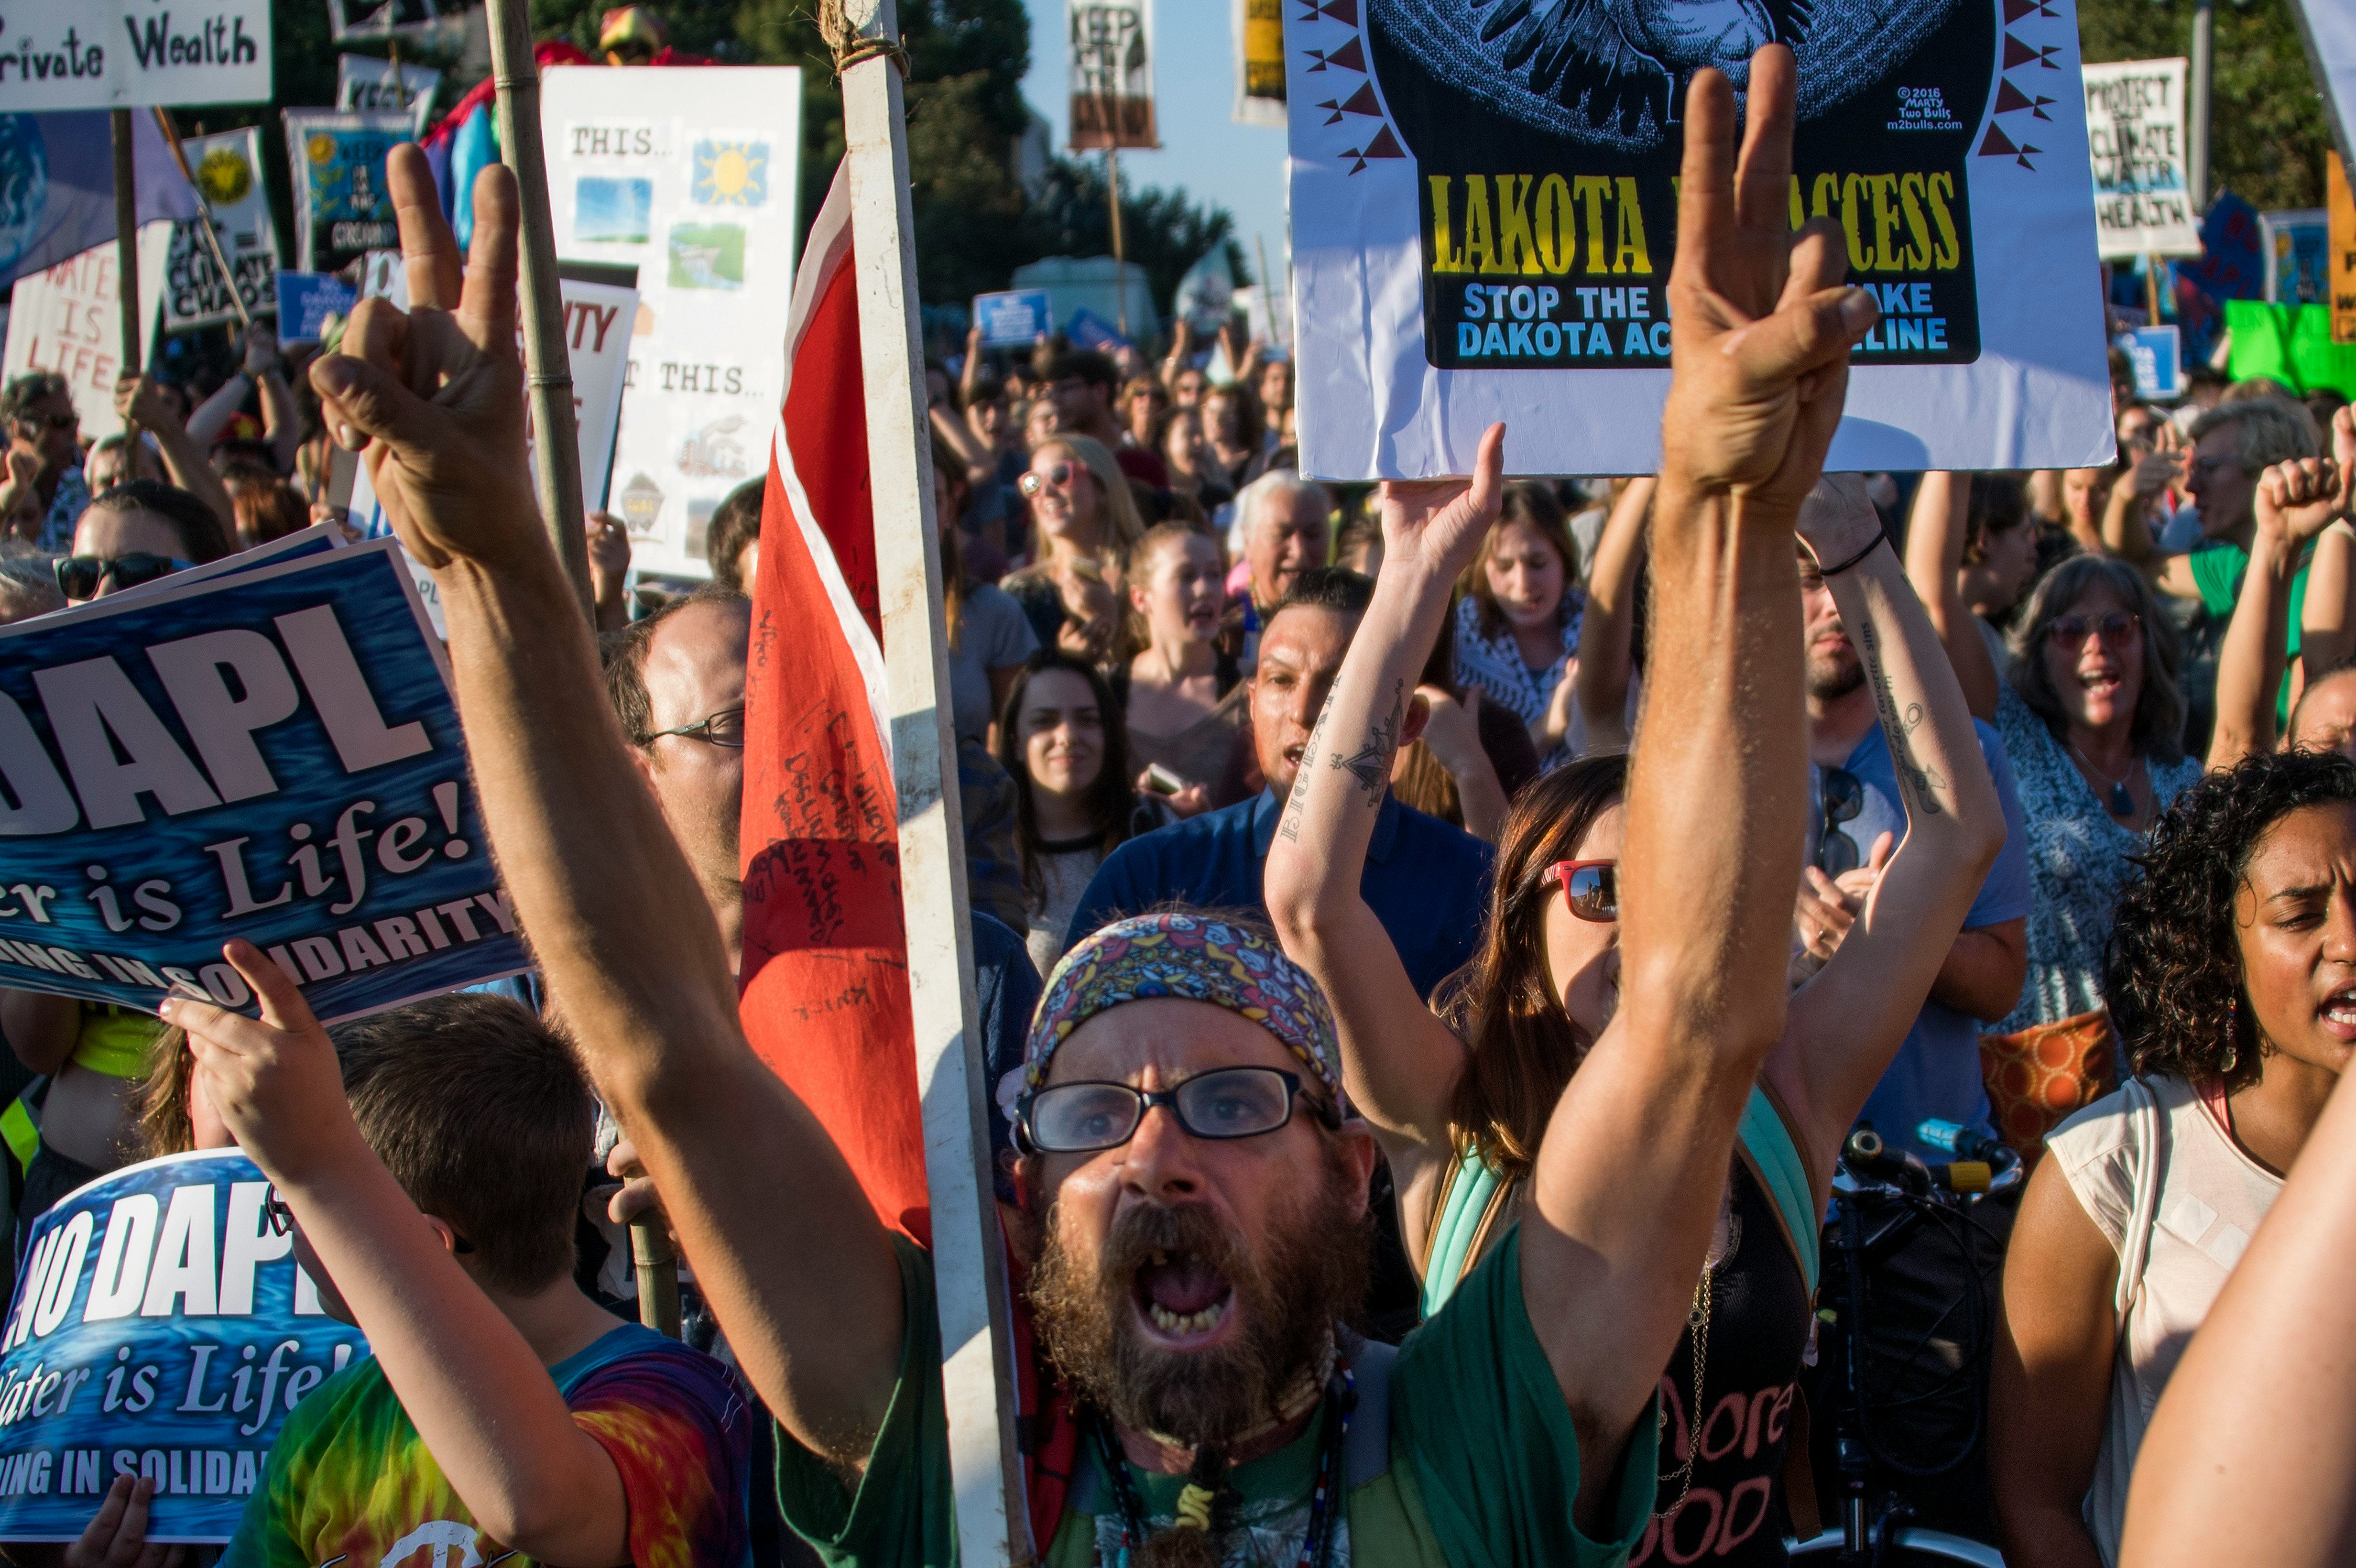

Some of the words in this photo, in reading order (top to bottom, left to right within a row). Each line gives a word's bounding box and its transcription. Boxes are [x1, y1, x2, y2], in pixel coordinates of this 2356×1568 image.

[0, 15, 104, 80] rivate
[125, 11, 256, 70] Wealth
[1898, 108, 1921, 118] Two
[1924, 108, 1951, 120] Bulls
[1905, 98, 1944, 108] MARTY
[1913, 87, 1940, 98] 2016
[572, 126, 673, 157] THIS...
[1887, 120, 1963, 130] m2bulls.com
[1428, 174, 1653, 274] LAKOTA
[1789, 172, 1959, 272] CESS
[58, 297, 106, 345] IS
[1464, 283, 1560, 319] STOP
[1576, 287, 1650, 319] THE
[1847, 283, 1933, 314] AKE
[1458, 322, 1614, 356] DAKOTA
[1852, 318, 1948, 350] LINE
[27, 335, 117, 390] LIFE
[659, 361, 765, 399] THIS...
[86, 864, 182, 933] is
[205, 782, 469, 919] Life!
[0, 938, 103, 980] ING
[91, 954, 171, 989] IN
[160, 889, 517, 1007] SOIDARITY
[0, 1210, 95, 1356] NO
[103, 1346, 160, 1413] is
[0, 1450, 53, 1496] ING
[60, 1450, 100, 1494] IN
[113, 1449, 267, 1494] SOLIDA
